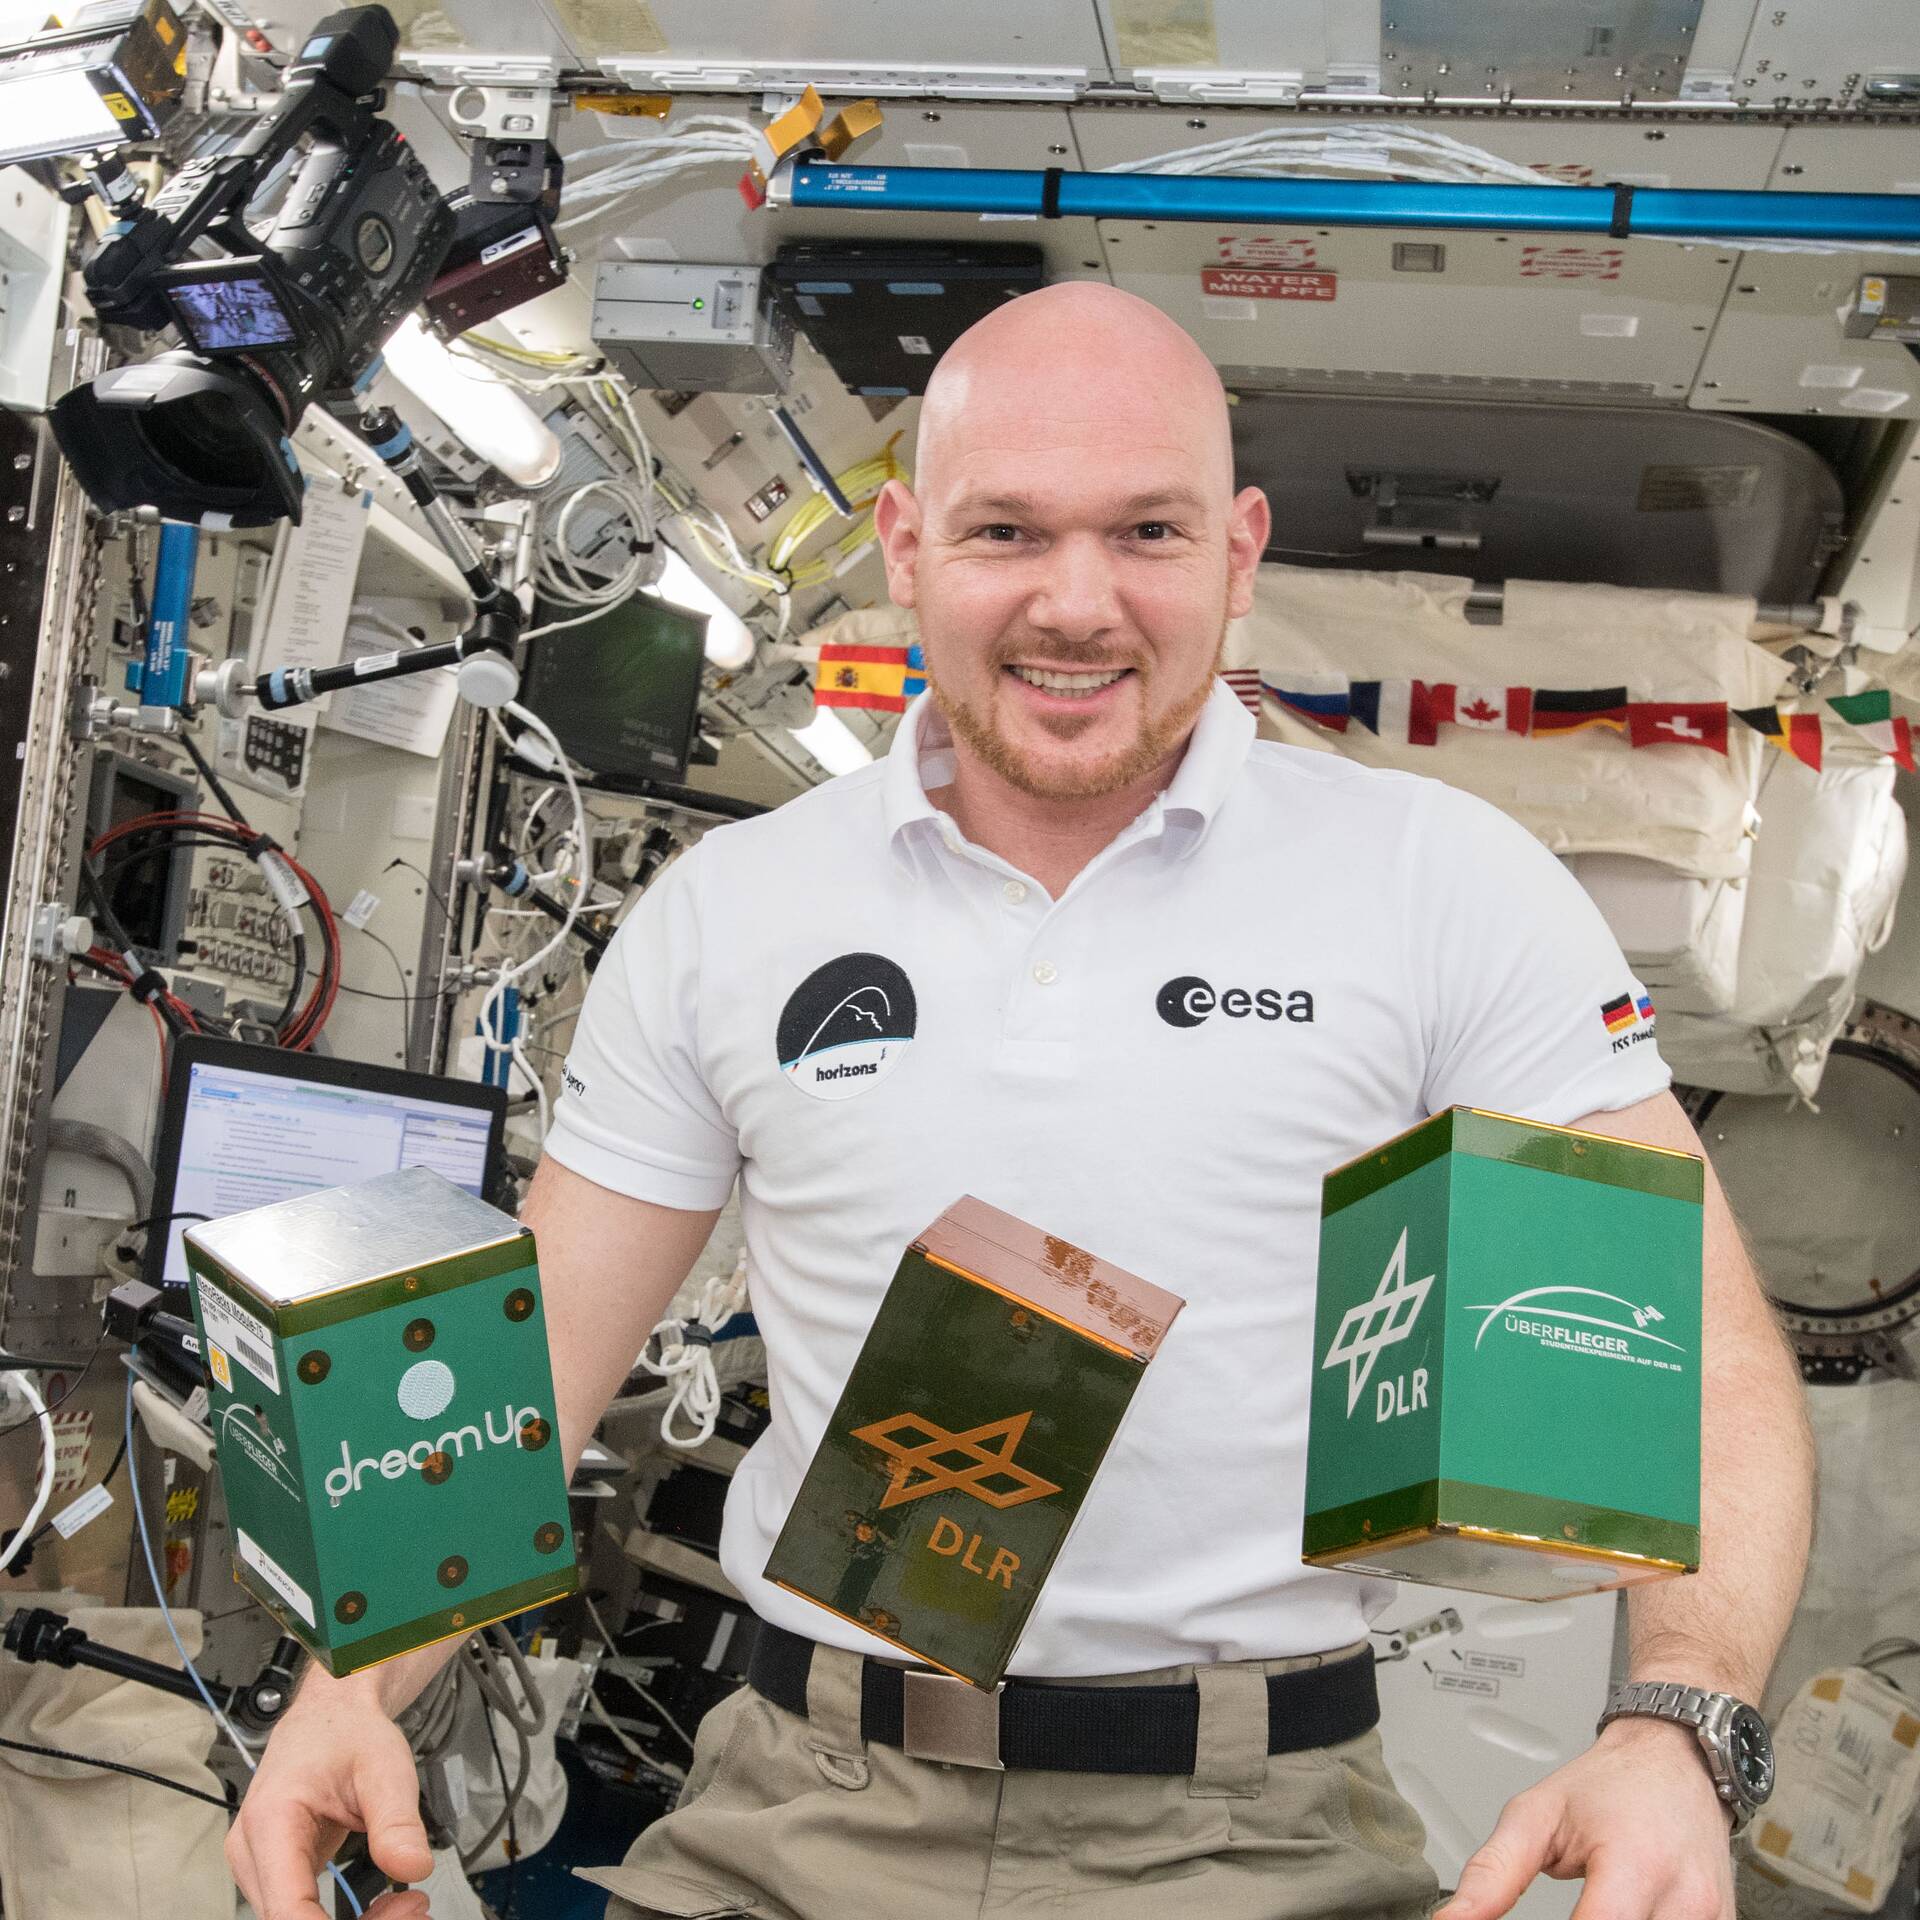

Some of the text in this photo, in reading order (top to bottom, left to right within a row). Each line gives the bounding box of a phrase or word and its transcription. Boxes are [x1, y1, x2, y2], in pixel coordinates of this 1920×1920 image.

[1208, 282, 1333, 297] MIST PFE
[1220, 273, 1321, 286] WATER
[815, 1063, 878, 1082] horizons
[1504, 1313, 1629, 1354] ÜBERFLIEGER
[1540, 1338, 1636, 1364] STUDENTENEXPERIMENTE
[1636, 1356, 1653, 1366] AUF
[1376, 1368, 1429, 1423] DLR
[927, 1515, 1021, 1590] DLR
